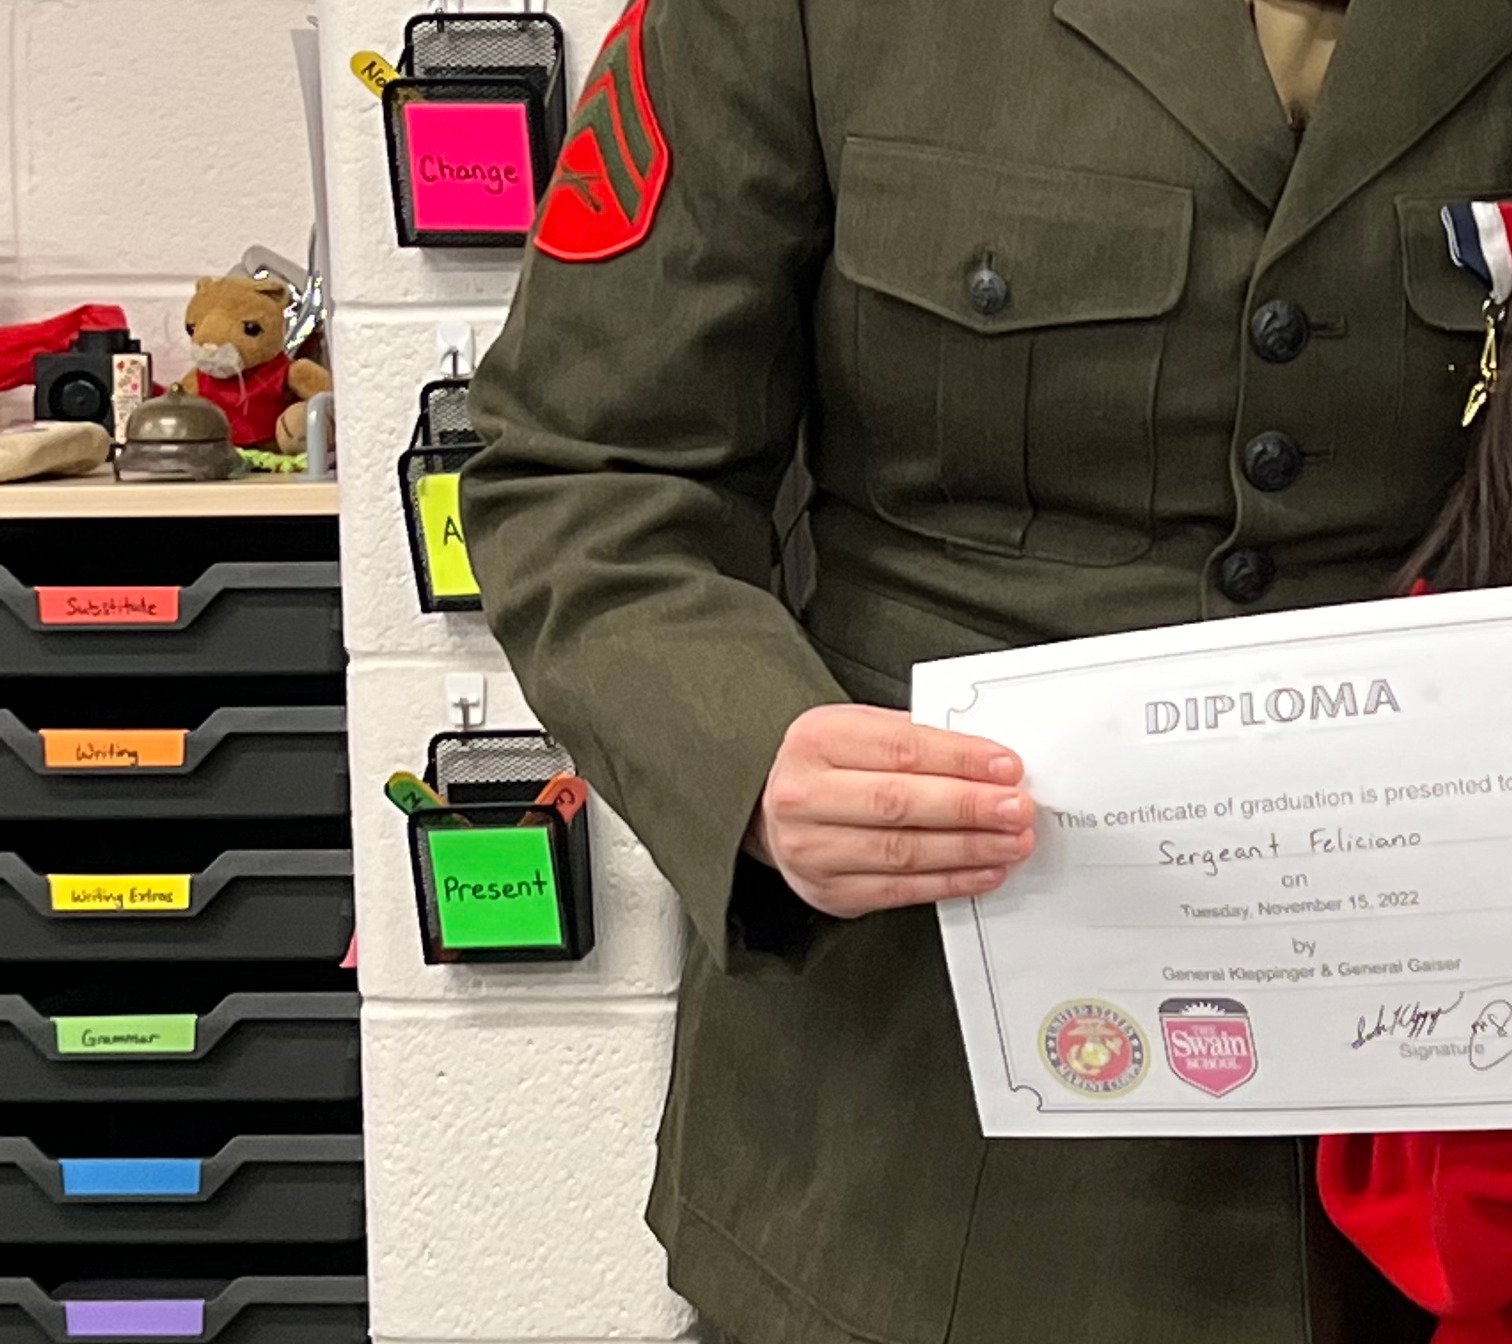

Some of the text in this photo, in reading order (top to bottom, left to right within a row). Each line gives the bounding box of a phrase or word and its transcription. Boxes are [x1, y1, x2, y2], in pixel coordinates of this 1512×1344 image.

[419, 154, 520, 195] Change
[66, 597, 158, 617] Substitute
[1144, 678, 1401, 735] DIPLOMA
[76, 742, 139, 766] Writing
[1052, 810, 1098, 829] This
[1103, 804, 1208, 828] certificate
[1213, 797, 1234, 817] of
[1240, 789, 1353, 819] graduation
[1360, 785, 1378, 804] is
[1384, 775, 1492, 806] presented
[1159, 827, 1422, 876] Sergeant Feliciano
[443, 869, 548, 902] Present
[1280, 872, 1310, 888] on
[71, 888, 174, 908] Writing Extras
[1180, 903, 1252, 921] Tuesday,
[1257, 898, 1343, 916] November
[1378, 890, 1420, 907] 2022
[1292, 937, 1317, 957] by
[1162, 966, 1225, 982] General
[1320, 963, 1334, 977] &
[1338, 960, 1403, 976] General
[81, 1029, 161, 1047] Grammar
[1171, 1029, 1248, 1057] Swain
[1399, 1041, 1486, 1061] Signature
